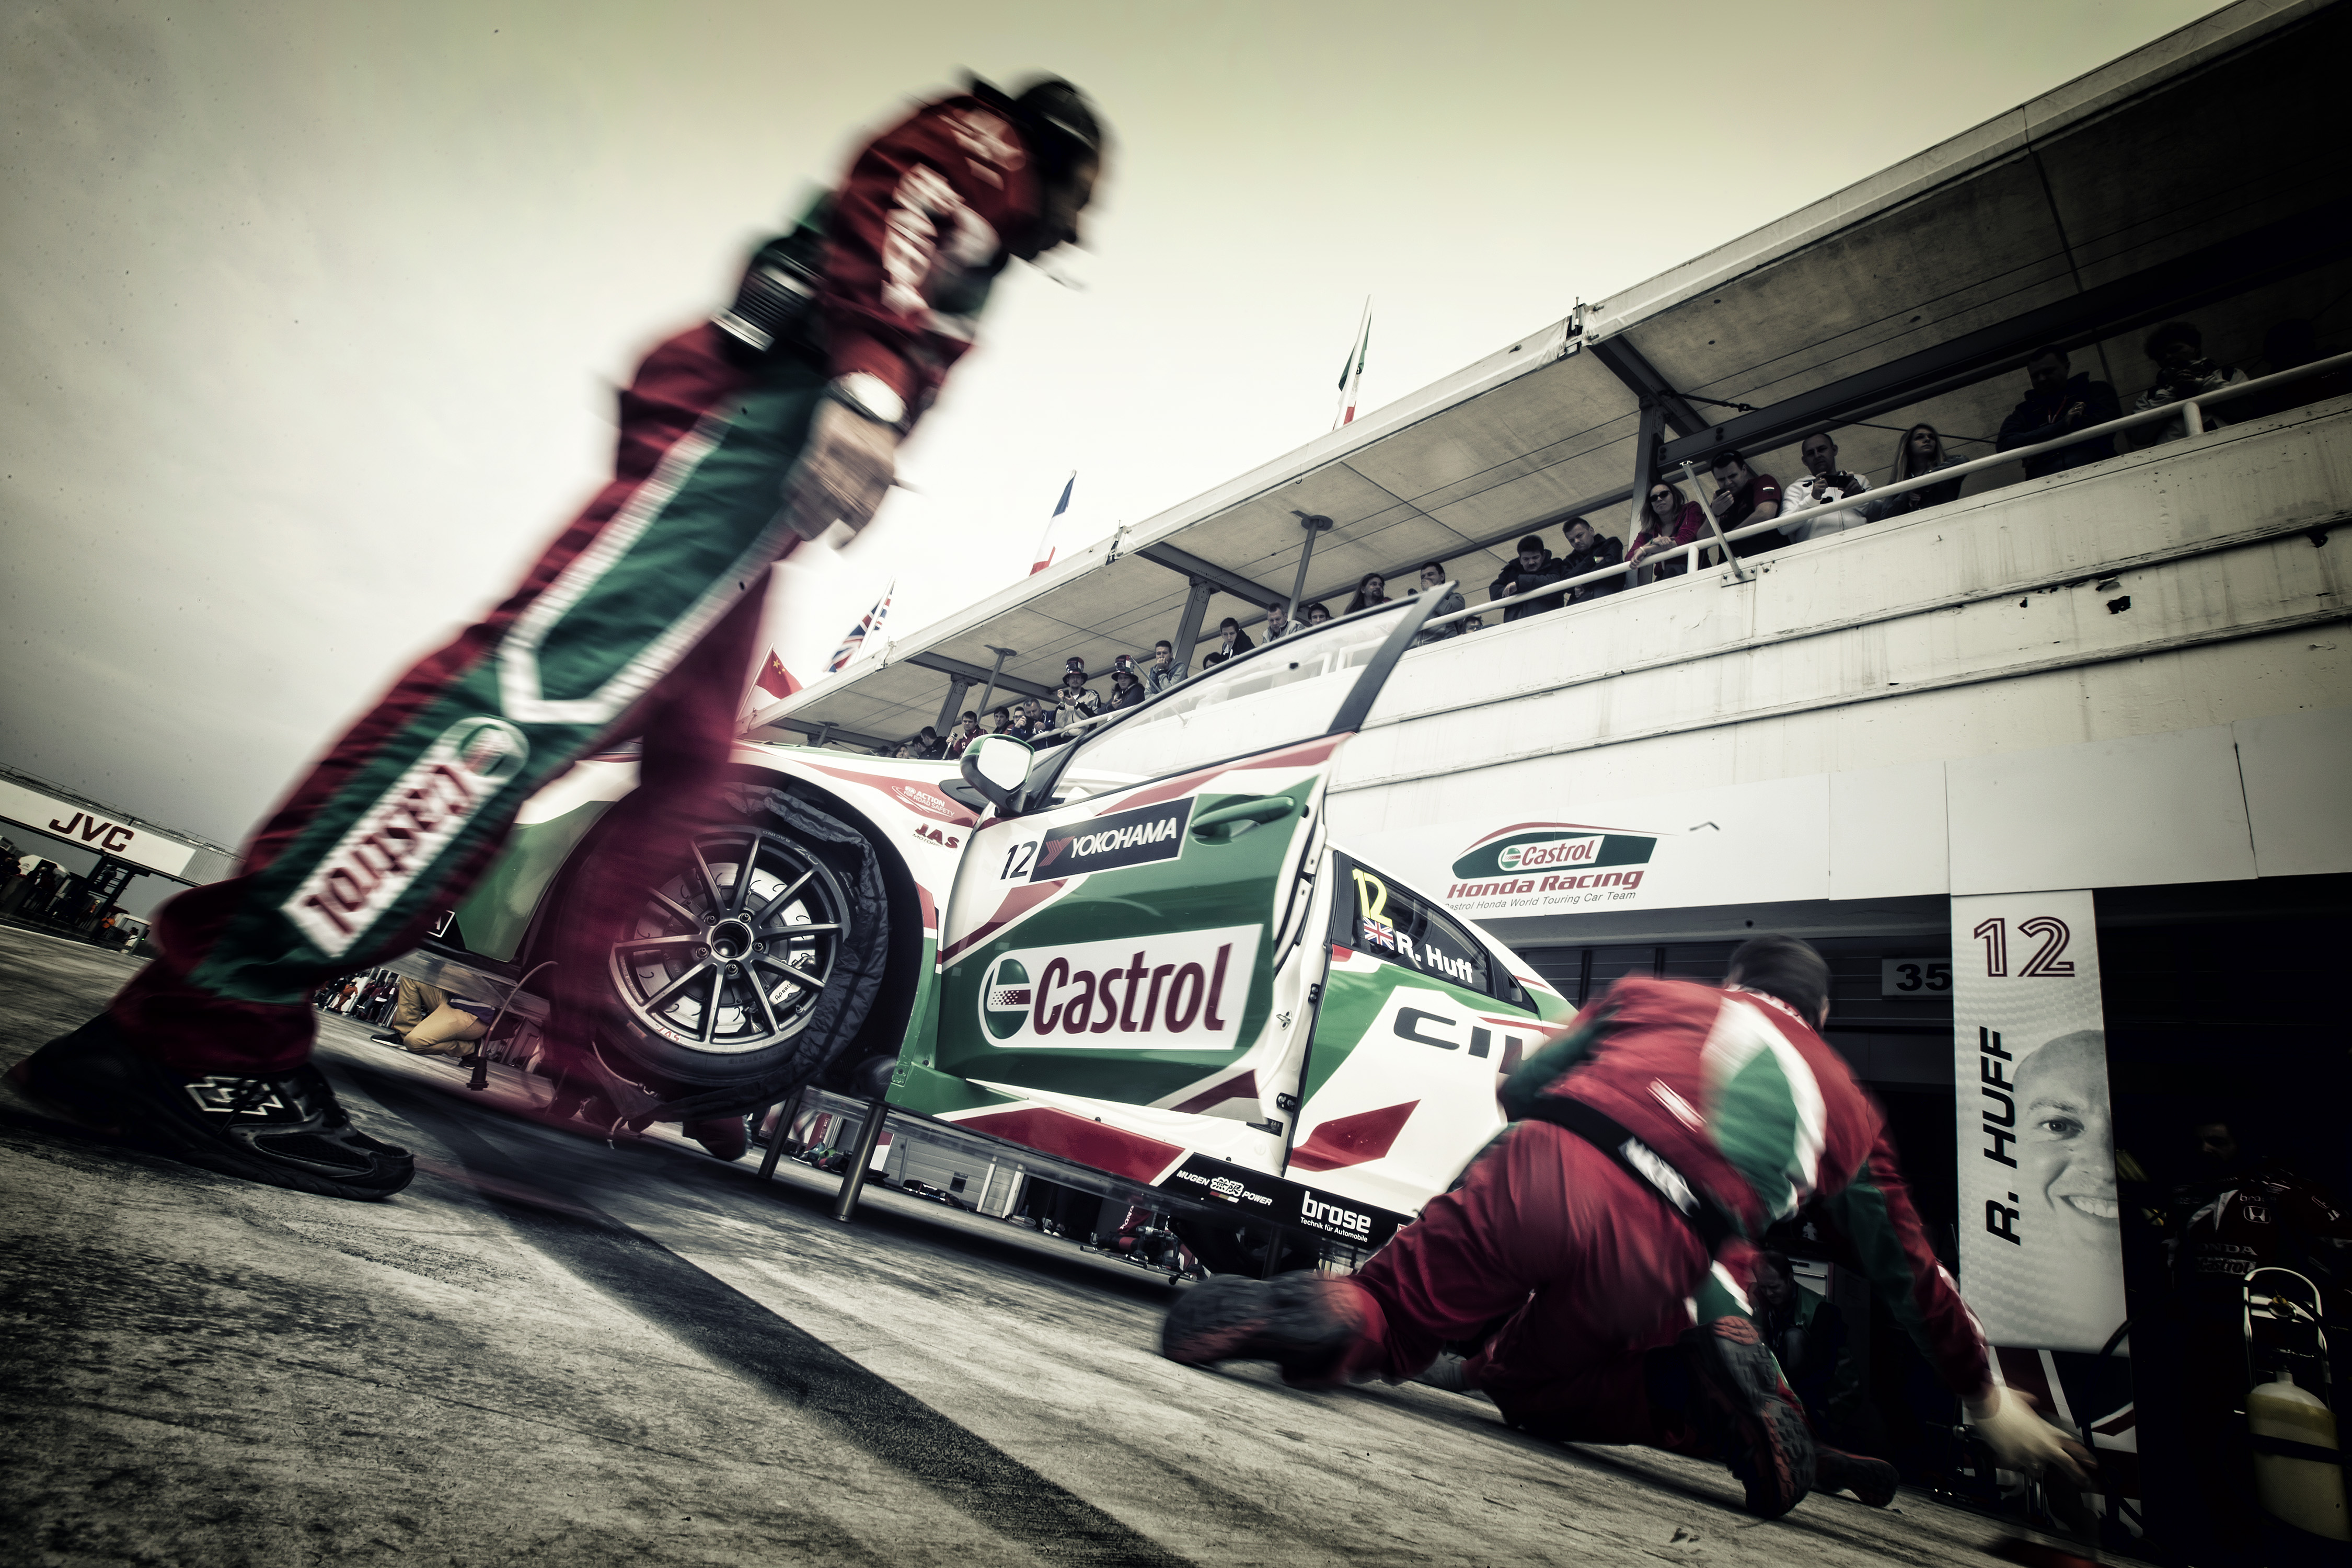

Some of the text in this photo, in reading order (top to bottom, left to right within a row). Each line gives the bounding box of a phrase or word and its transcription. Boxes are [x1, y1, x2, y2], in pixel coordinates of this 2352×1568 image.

[913, 795, 930, 806] ROAD
[931, 803, 955, 816] SAFETY
[916, 791, 945, 808] ACTION
[49, 812, 134, 853] JVC
[915, 823, 960, 848] JAS
[1071, 817, 1177, 858] YOKOHAMA
[1000, 841, 1038, 880] 12
[1521, 839, 1595, 867] Castrol
[1352, 868, 1393, 928] 12
[1446, 870, 1645, 899] Honda Racing
[1476, 900, 1507, 909] Honda
[1511, 897, 1540, 907] World
[1542, 894, 1581, 906] Touring
[1584, 893, 1604, 903] Car
[1607, 891, 1636, 901] Team
[1396, 930, 1473, 984] R. Huff
[1973, 915, 2076, 977] 12
[1033, 942, 1234, 1036] Castrol
[1895, 963, 1953, 992] 35
[1979, 1025, 2021, 1246] R. HUFF
[1177, 1170, 1210, 1186] MUGEN
[1241, 1191, 1273, 1206] POWER
[1301, 1190, 1371, 1234] brose
[1300, 1216, 1368, 1243] Technik für Automobile
